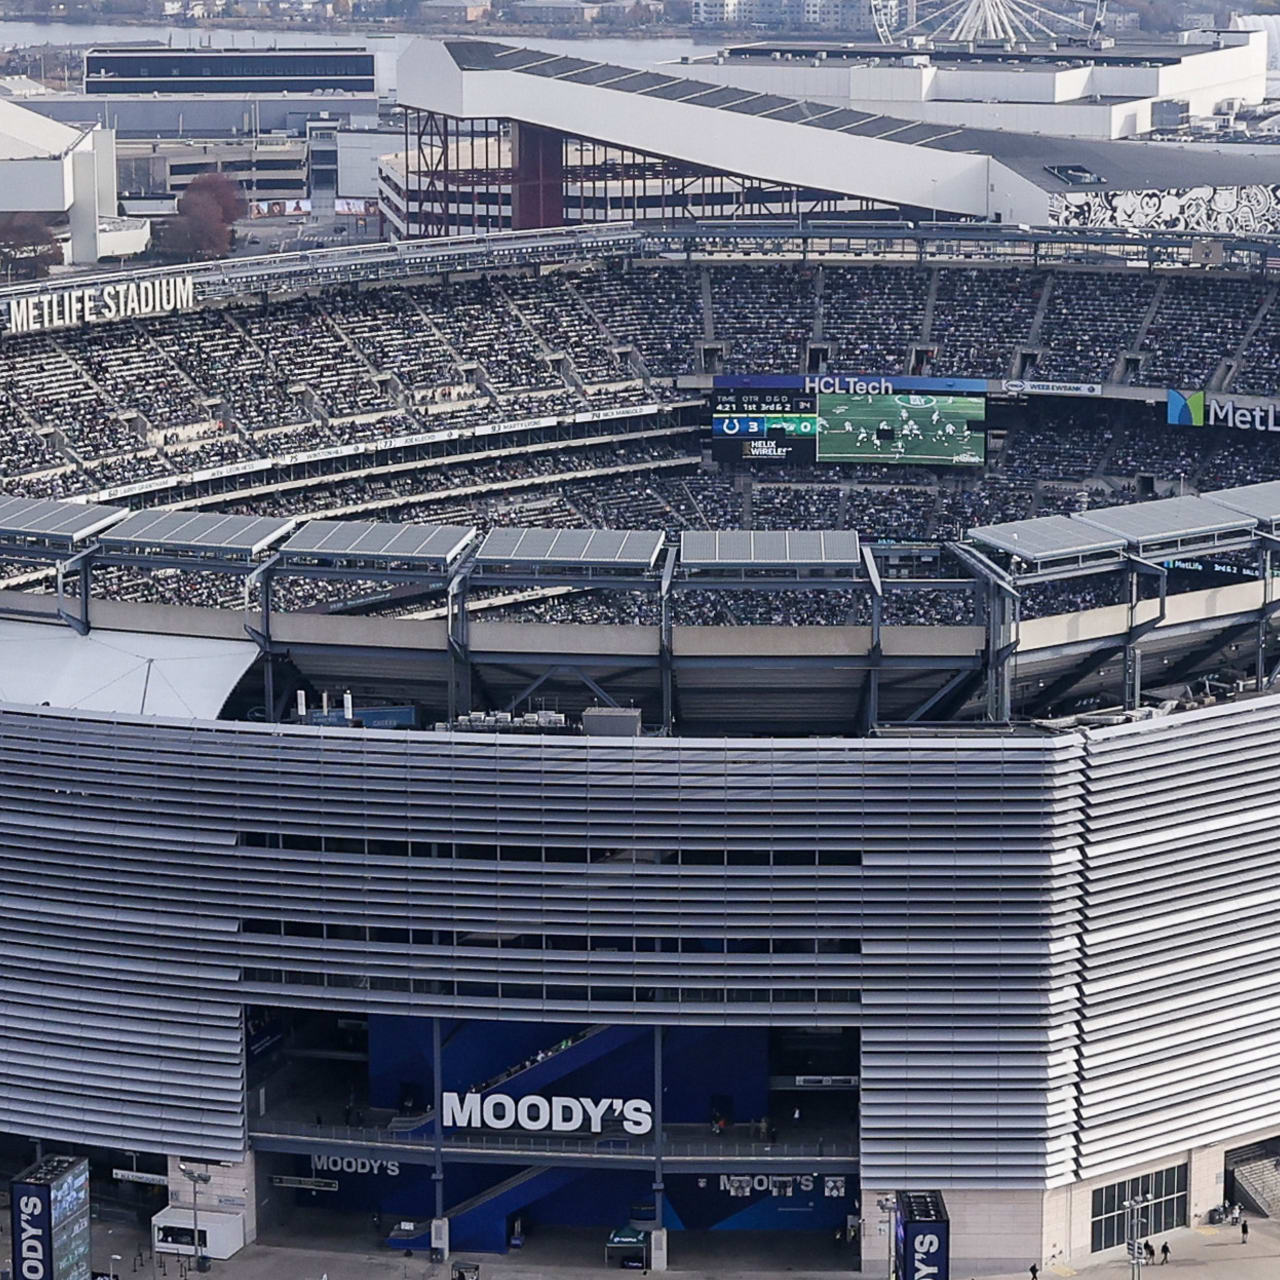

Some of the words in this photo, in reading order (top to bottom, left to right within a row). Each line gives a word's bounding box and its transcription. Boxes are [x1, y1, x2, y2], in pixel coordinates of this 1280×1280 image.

[10, 288, 97, 333] METLIFE
[101, 276, 193, 319] STADIUM
[805, 376, 893, 395] HCLTech
[748, 421, 759, 432] 3
[800, 421, 811, 432] 0
[442, 1091, 653, 1135] MOODY'S
[311, 1154, 400, 1176] MOODY'S
